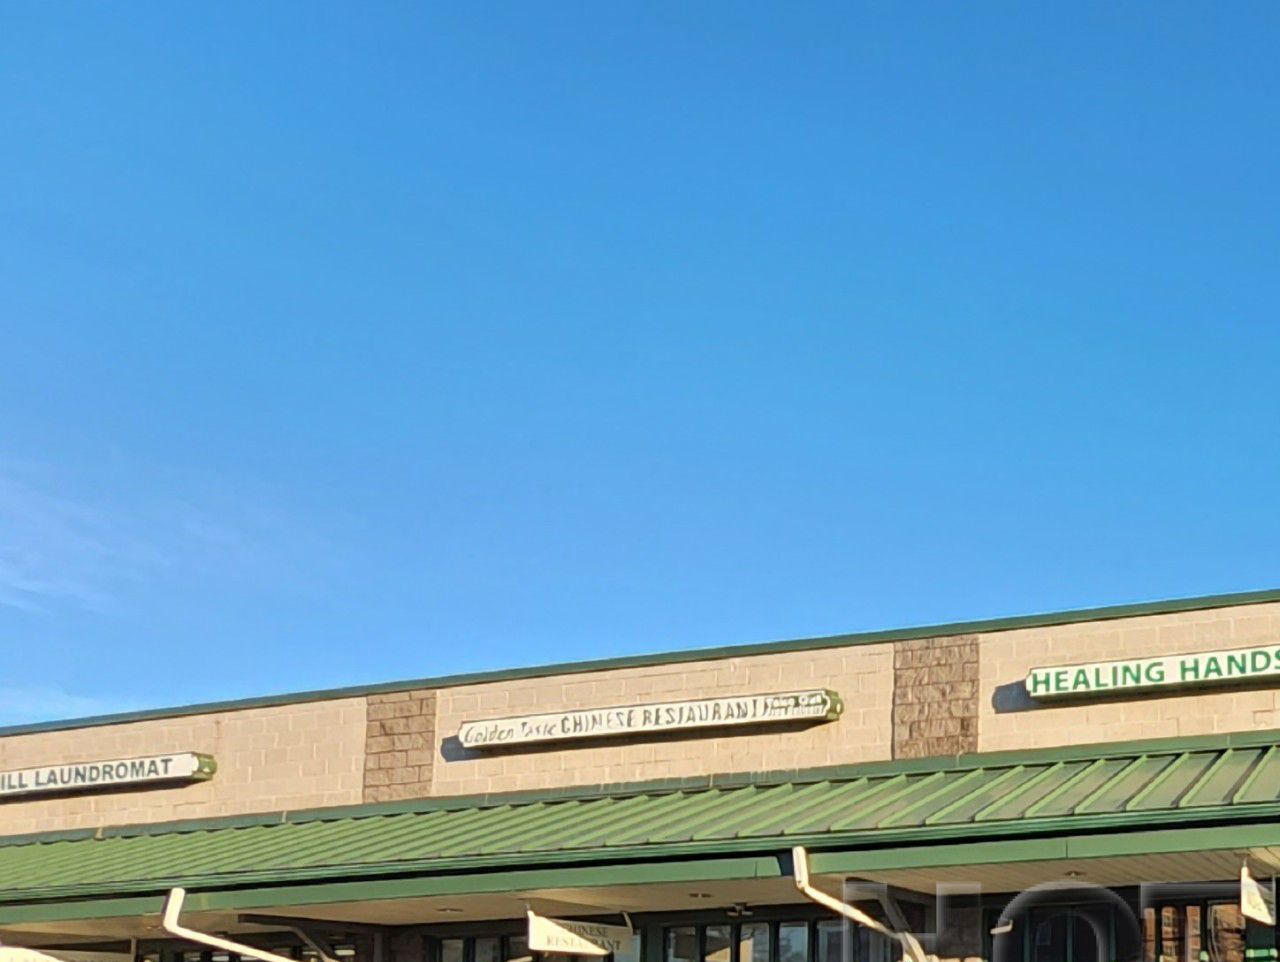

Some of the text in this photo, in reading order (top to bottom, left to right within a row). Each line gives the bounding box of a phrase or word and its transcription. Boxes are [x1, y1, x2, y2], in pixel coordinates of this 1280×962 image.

[1031, 660, 1165, 694] HEALING
[560, 709, 635, 734] CHINESE
[642, 699, 760, 728] RESTAURANT
[35, 758, 173, 788] LAUNDROMAT
